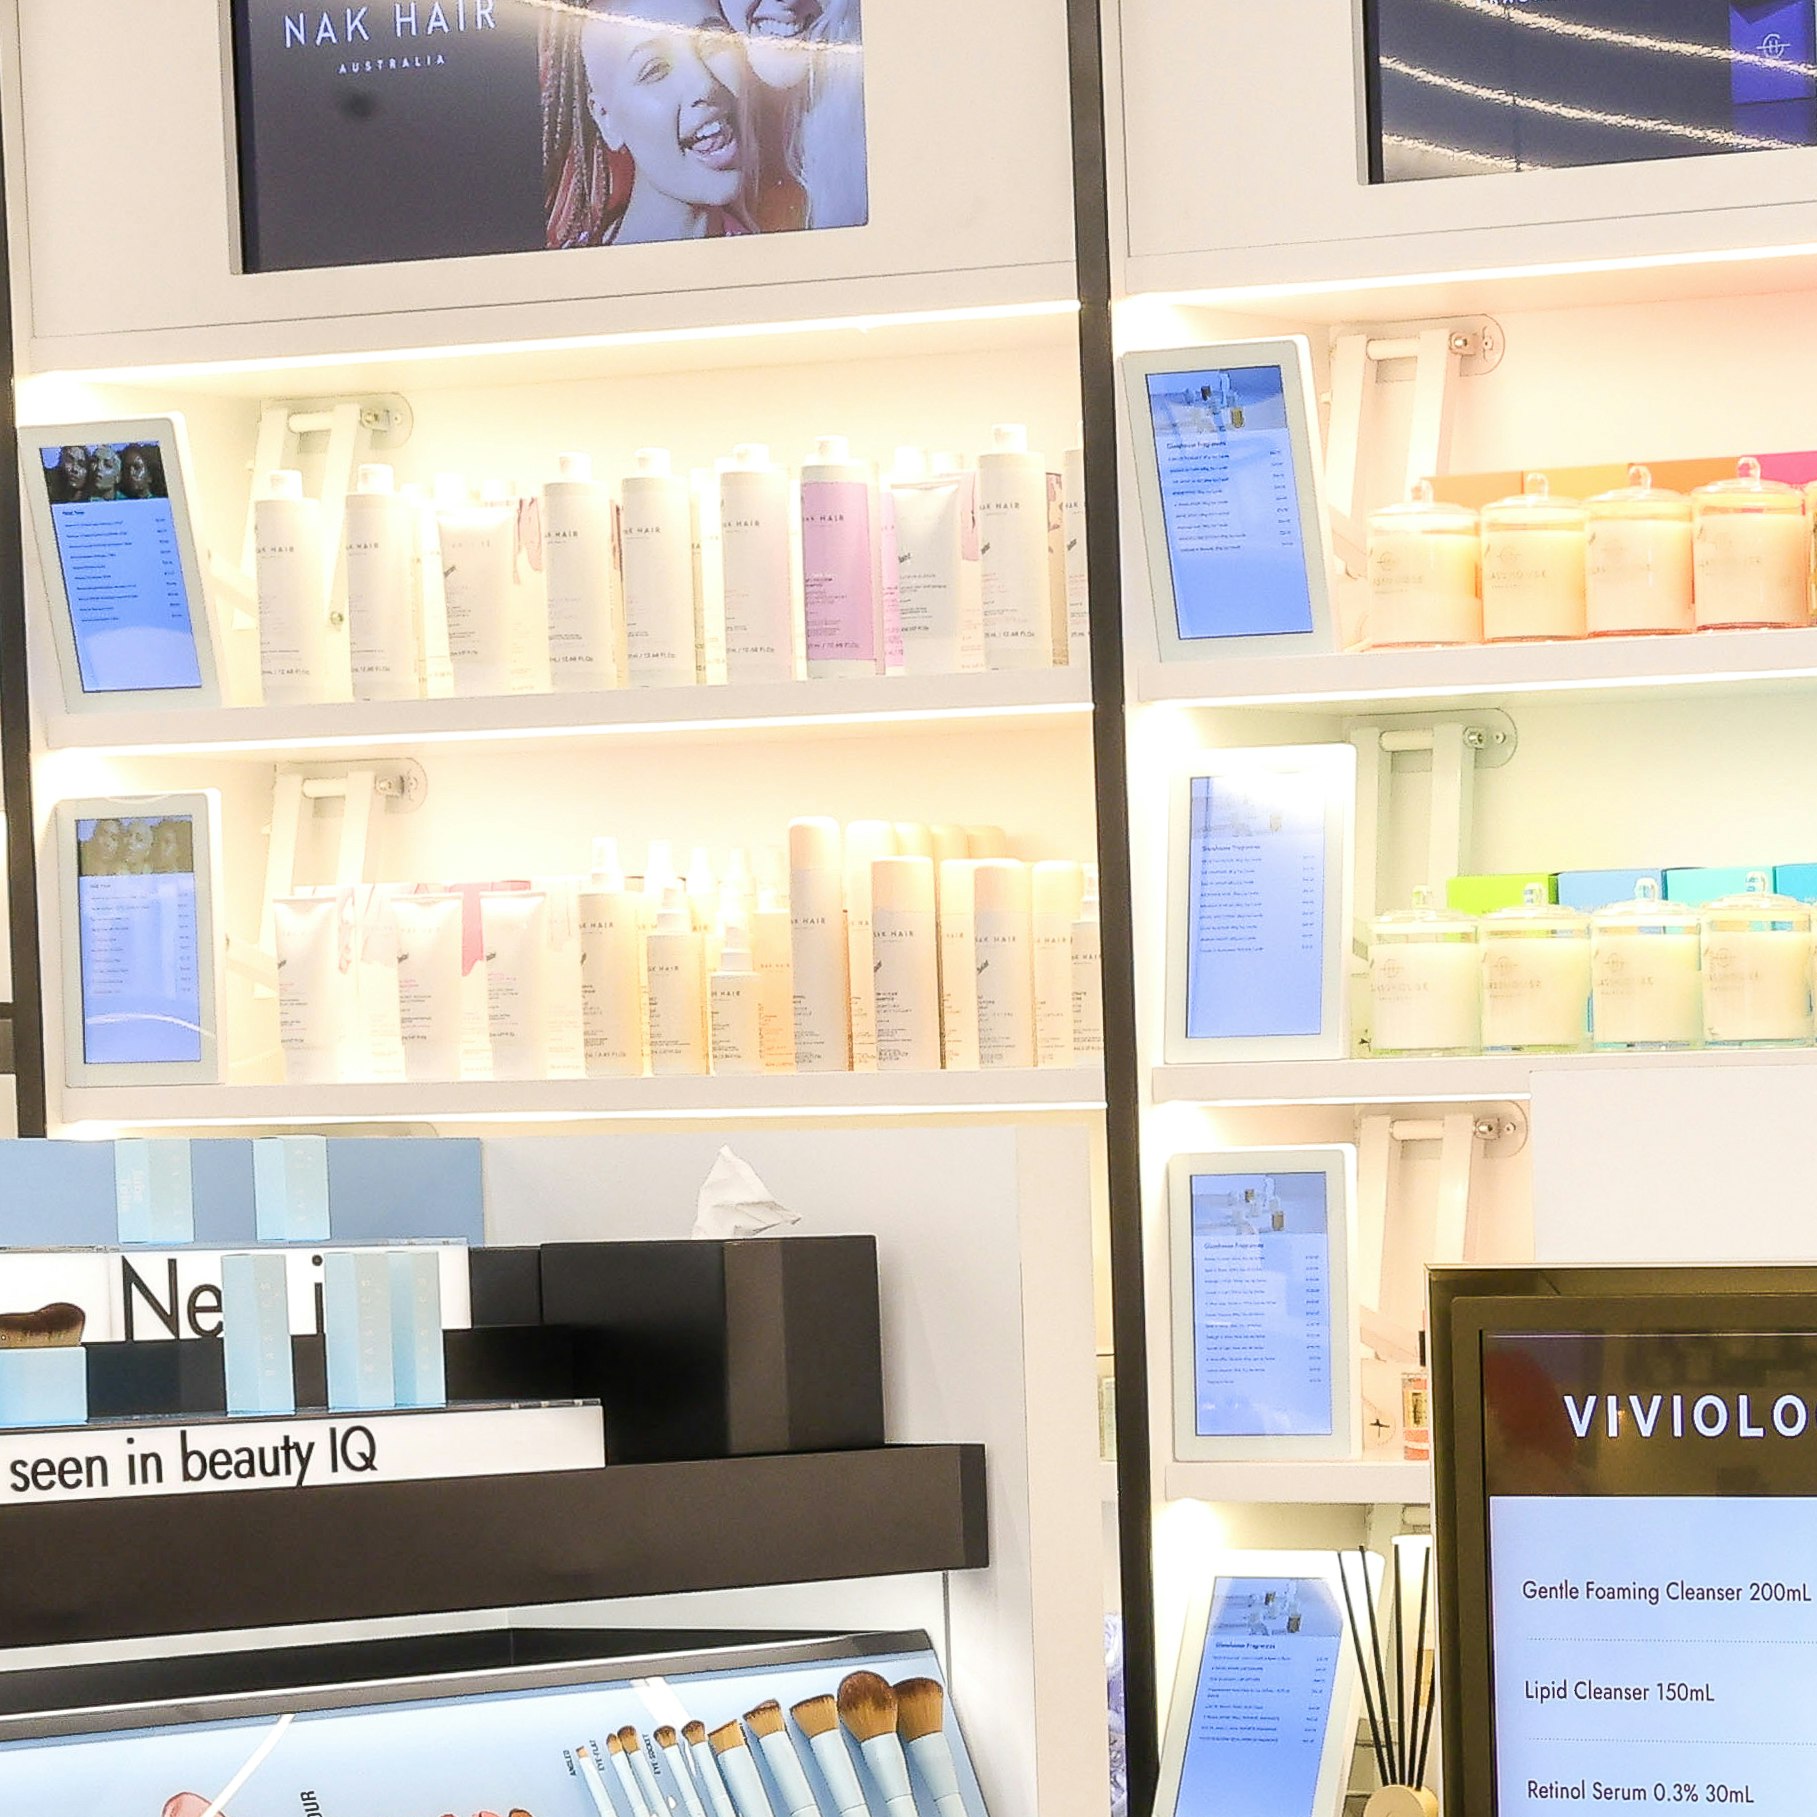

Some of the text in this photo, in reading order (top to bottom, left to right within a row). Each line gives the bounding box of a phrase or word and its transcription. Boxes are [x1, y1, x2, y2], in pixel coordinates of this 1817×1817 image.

[283, 0, 498, 48] NAK HAIR
[338, 54, 446, 74] AUSTRALIA
[122, 1256, 223, 1341] Ne
[10, 1425, 377, 1492] seen in beauty IQ
[1522, 1580, 1580, 1601] Gentle
[1586, 1581, 1660, 1605] Foaming
[1666, 1581, 1743, 1602] Cleanser
[1749, 1583, 1812, 1603] 200mL
[1525, 1681, 1568, 1704] Lipid
[1574, 1681, 1649, 1702] Cleanser
[1657, 1682, 1715, 1702] 150mL
[1528, 1781, 1586, 1801] Retinol
[1592, 1783, 1648, 1802] Serum
[1653, 1783, 1698, 1803] 0.3%
[1705, 1783, 1754, 1804] 30mL
